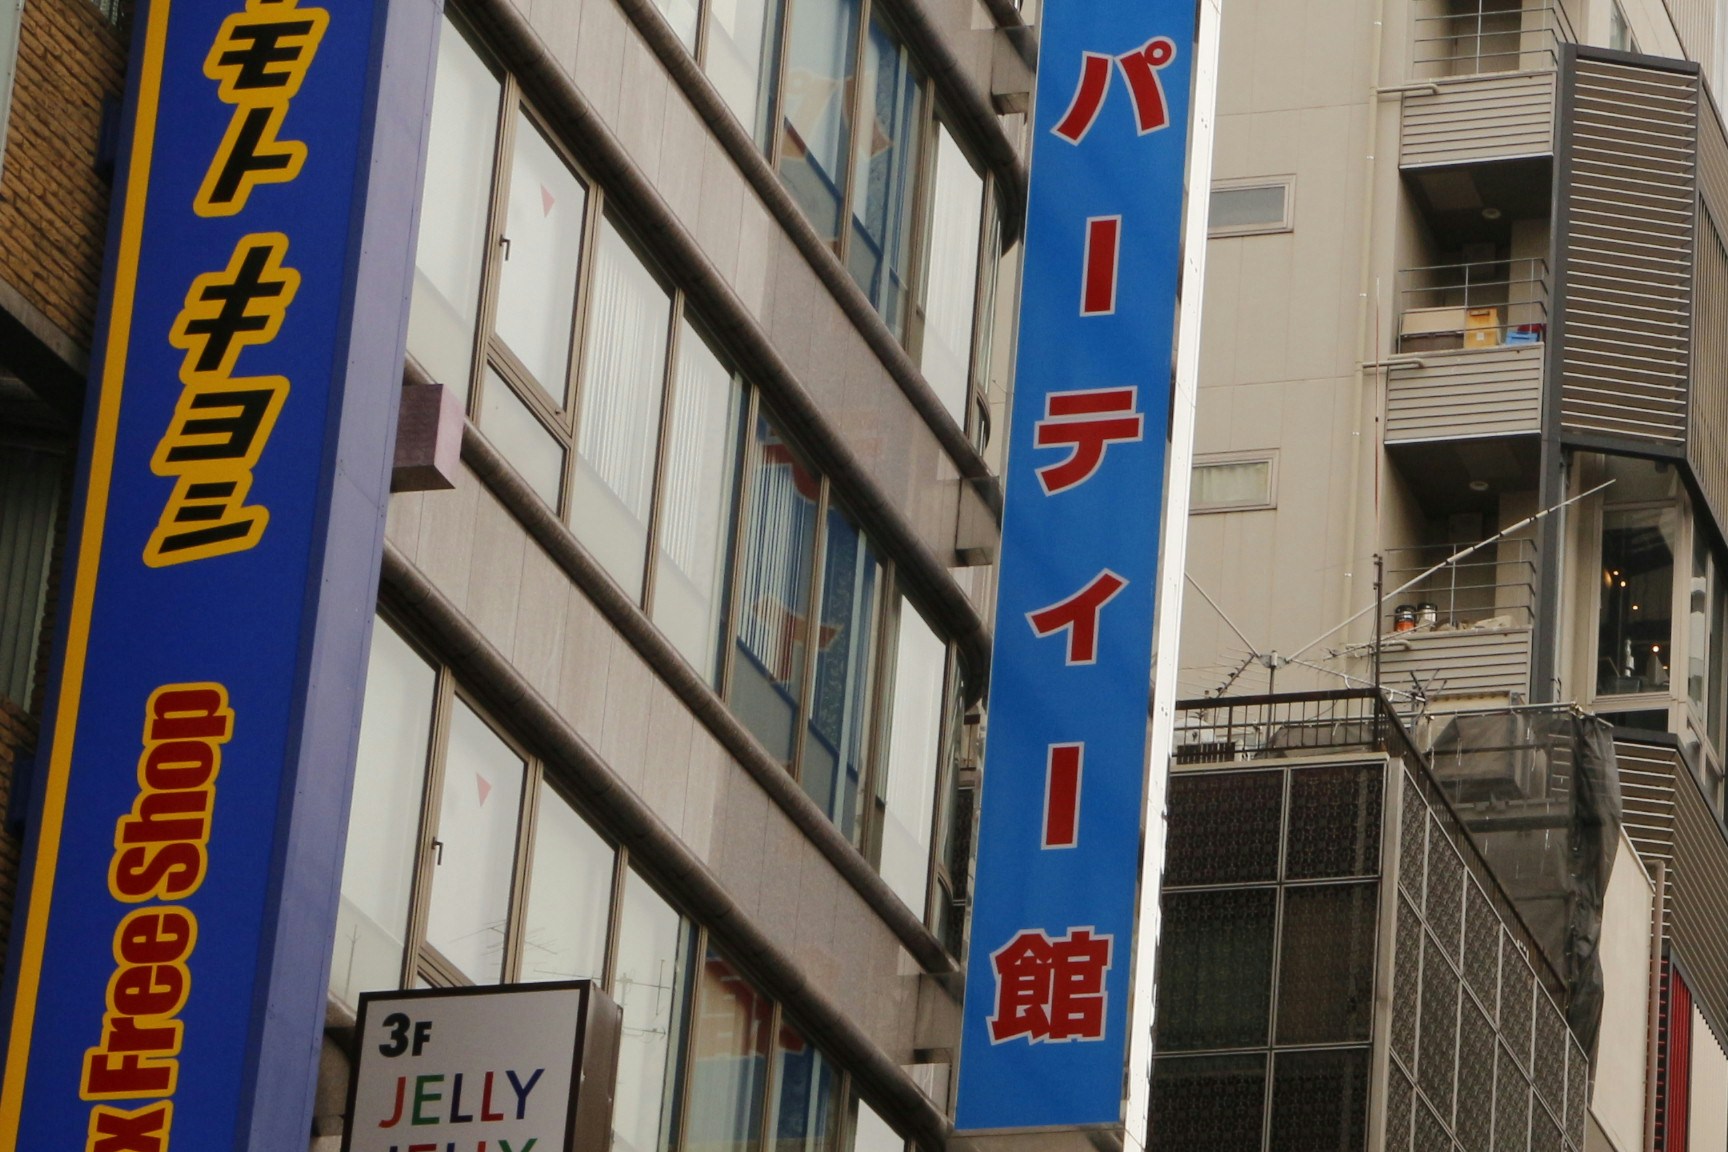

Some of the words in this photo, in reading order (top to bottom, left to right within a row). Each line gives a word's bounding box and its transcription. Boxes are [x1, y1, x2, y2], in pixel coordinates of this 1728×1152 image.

[145, 0, 328, 566] モトキヨシ
[985, 36, 1176, 1046] パーティー館
[112, 686, 230, 900] Shop
[84, 908, 195, 1098] Free
[378, 1012, 433, 1058] 3F
[378, 1068, 545, 1128] JELLY
